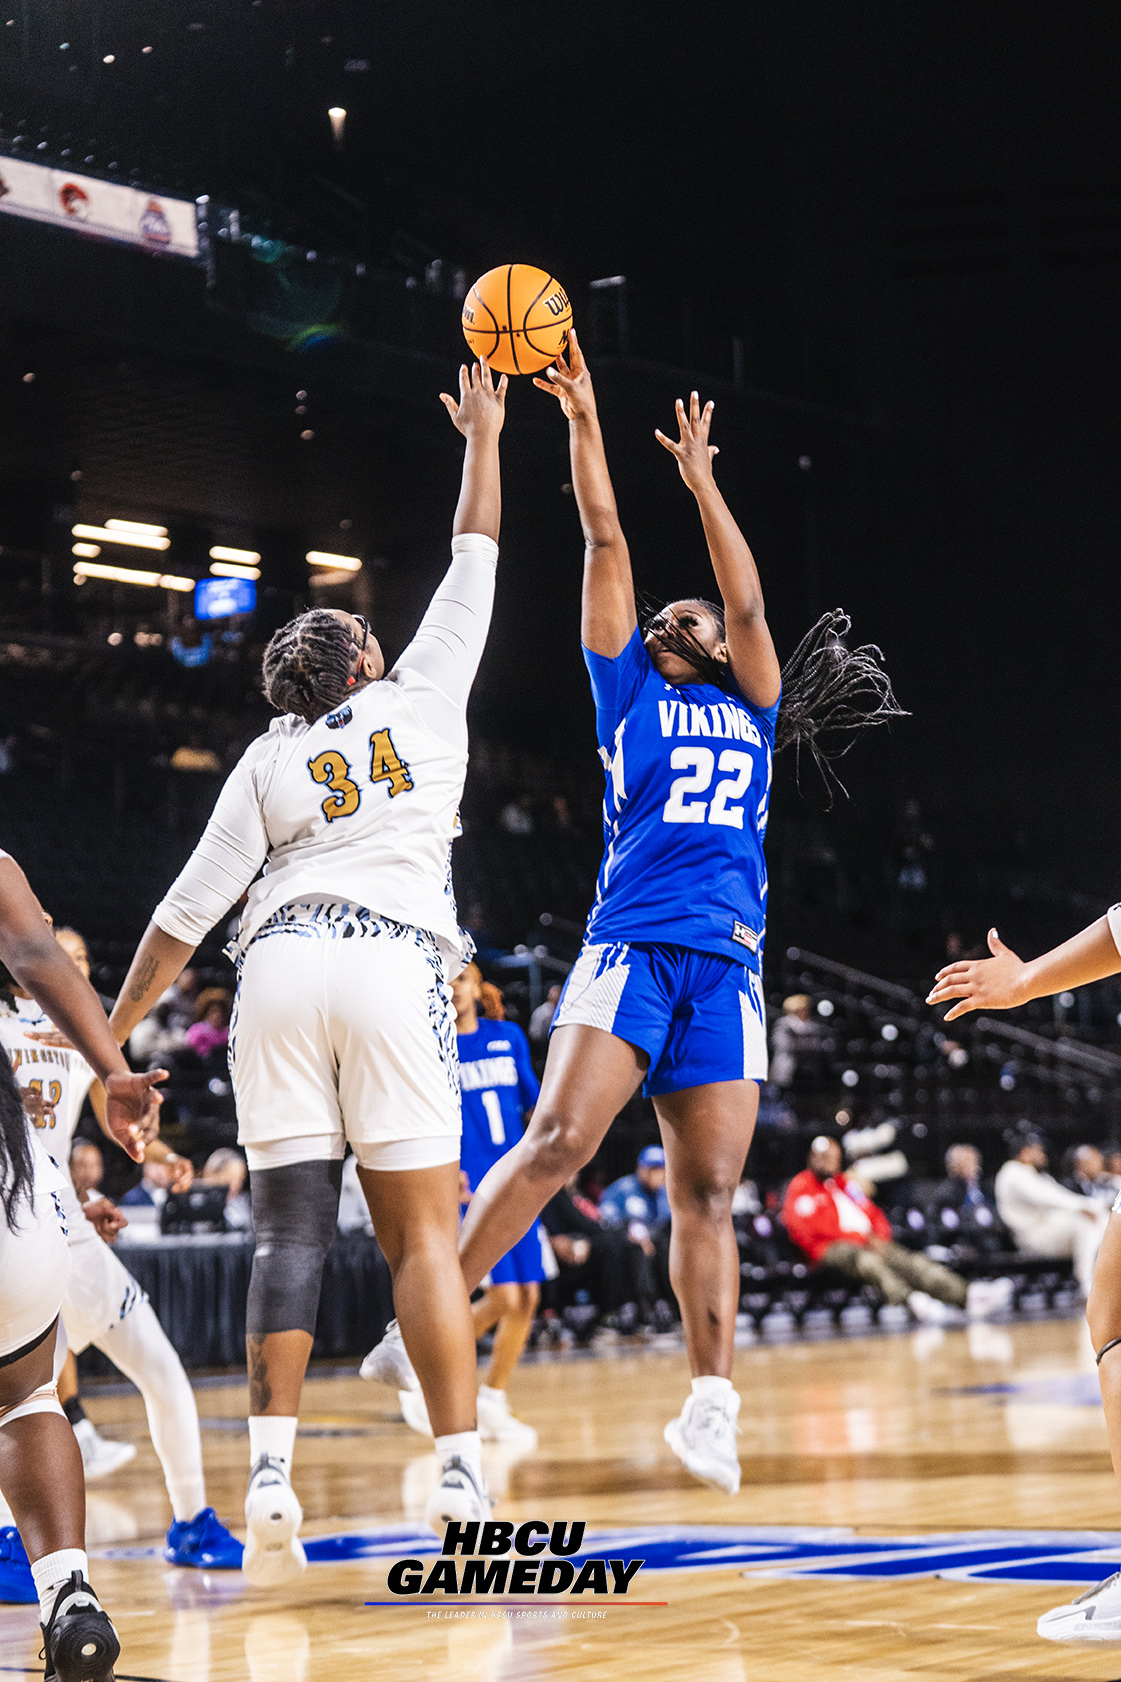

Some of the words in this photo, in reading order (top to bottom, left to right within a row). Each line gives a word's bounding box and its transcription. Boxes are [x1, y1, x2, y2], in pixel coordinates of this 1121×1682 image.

[307, 727, 414, 823] 34
[662, 746, 754, 830] 22
[459, 1056, 518, 1091] IKINGS
[481, 1090, 506, 1145] 1
